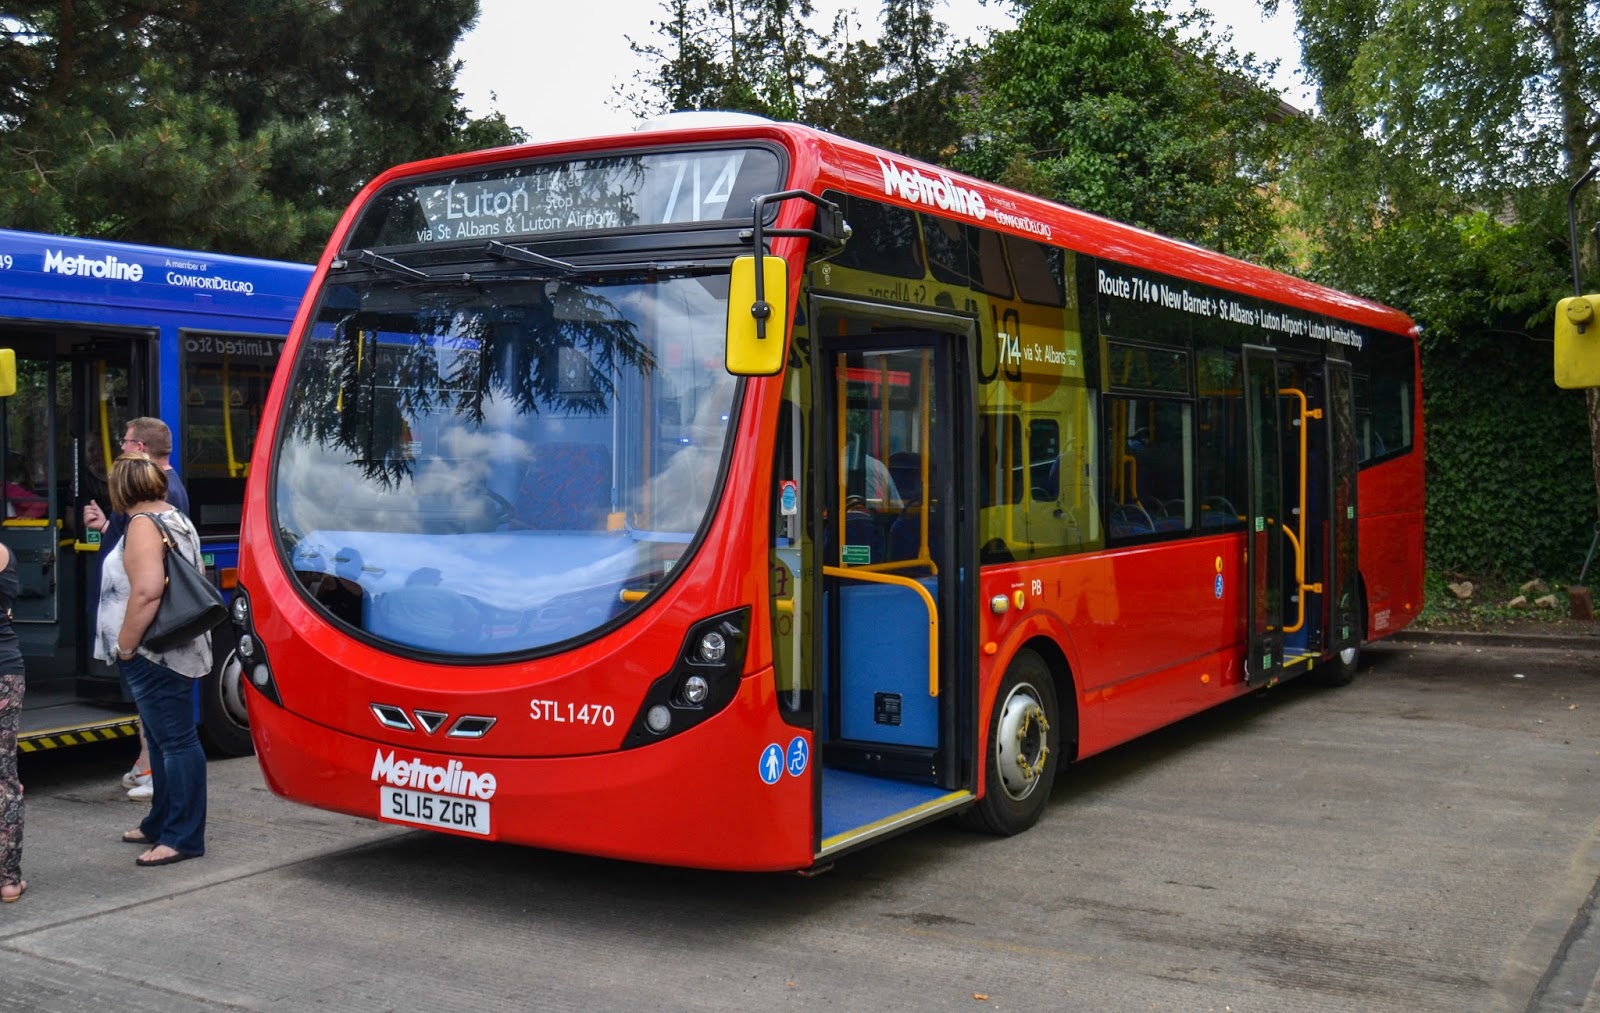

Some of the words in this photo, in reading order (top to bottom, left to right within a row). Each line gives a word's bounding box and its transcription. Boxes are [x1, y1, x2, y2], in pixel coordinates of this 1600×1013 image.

[447, 188, 529, 220] Luton
[545, 195, 573, 211] Stop
[660, 155, 737, 224] 714
[876, 154, 986, 221] Metroline
[416, 227, 433, 242] via
[437, 223, 451, 240] St
[456, 221, 500, 238] Albans
[505, 217, 515, 233] &
[521, 215, 560, 232] Luton
[566, 209, 617, 230] Airport
[43, 249, 144, 282] Metroline
[165, 259, 172, 268] A
[172, 261, 199, 270] member
[199, 263, 207, 271] of
[1098, 269, 1130, 299] Route
[1131, 277, 1151, 303] 714
[1160, 284, 1181, 310] New
[1182, 289, 1211, 317] Barnet
[1219, 299, 1229, 320] St
[1229, 301, 1255, 326] Albans
[1260, 308, 1281, 331] Luton
[1280, 313, 1304, 338] Airport
[1308, 320, 1326, 341] Luton
[1330, 325, 1351, 346] Limited
[1350, 329, 1362, 352] Stop
[998, 332, 1022, 365] 714
[1024, 344, 1033, 361] via
[1044, 344, 1067, 365] Albans
[1031, 579, 1042, 596] PB
[529, 699, 615, 726] STL1470
[370, 748, 498, 800] Metroline
[392, 792, 434, 820] SL15
[438, 799, 477, 828] ZGR
